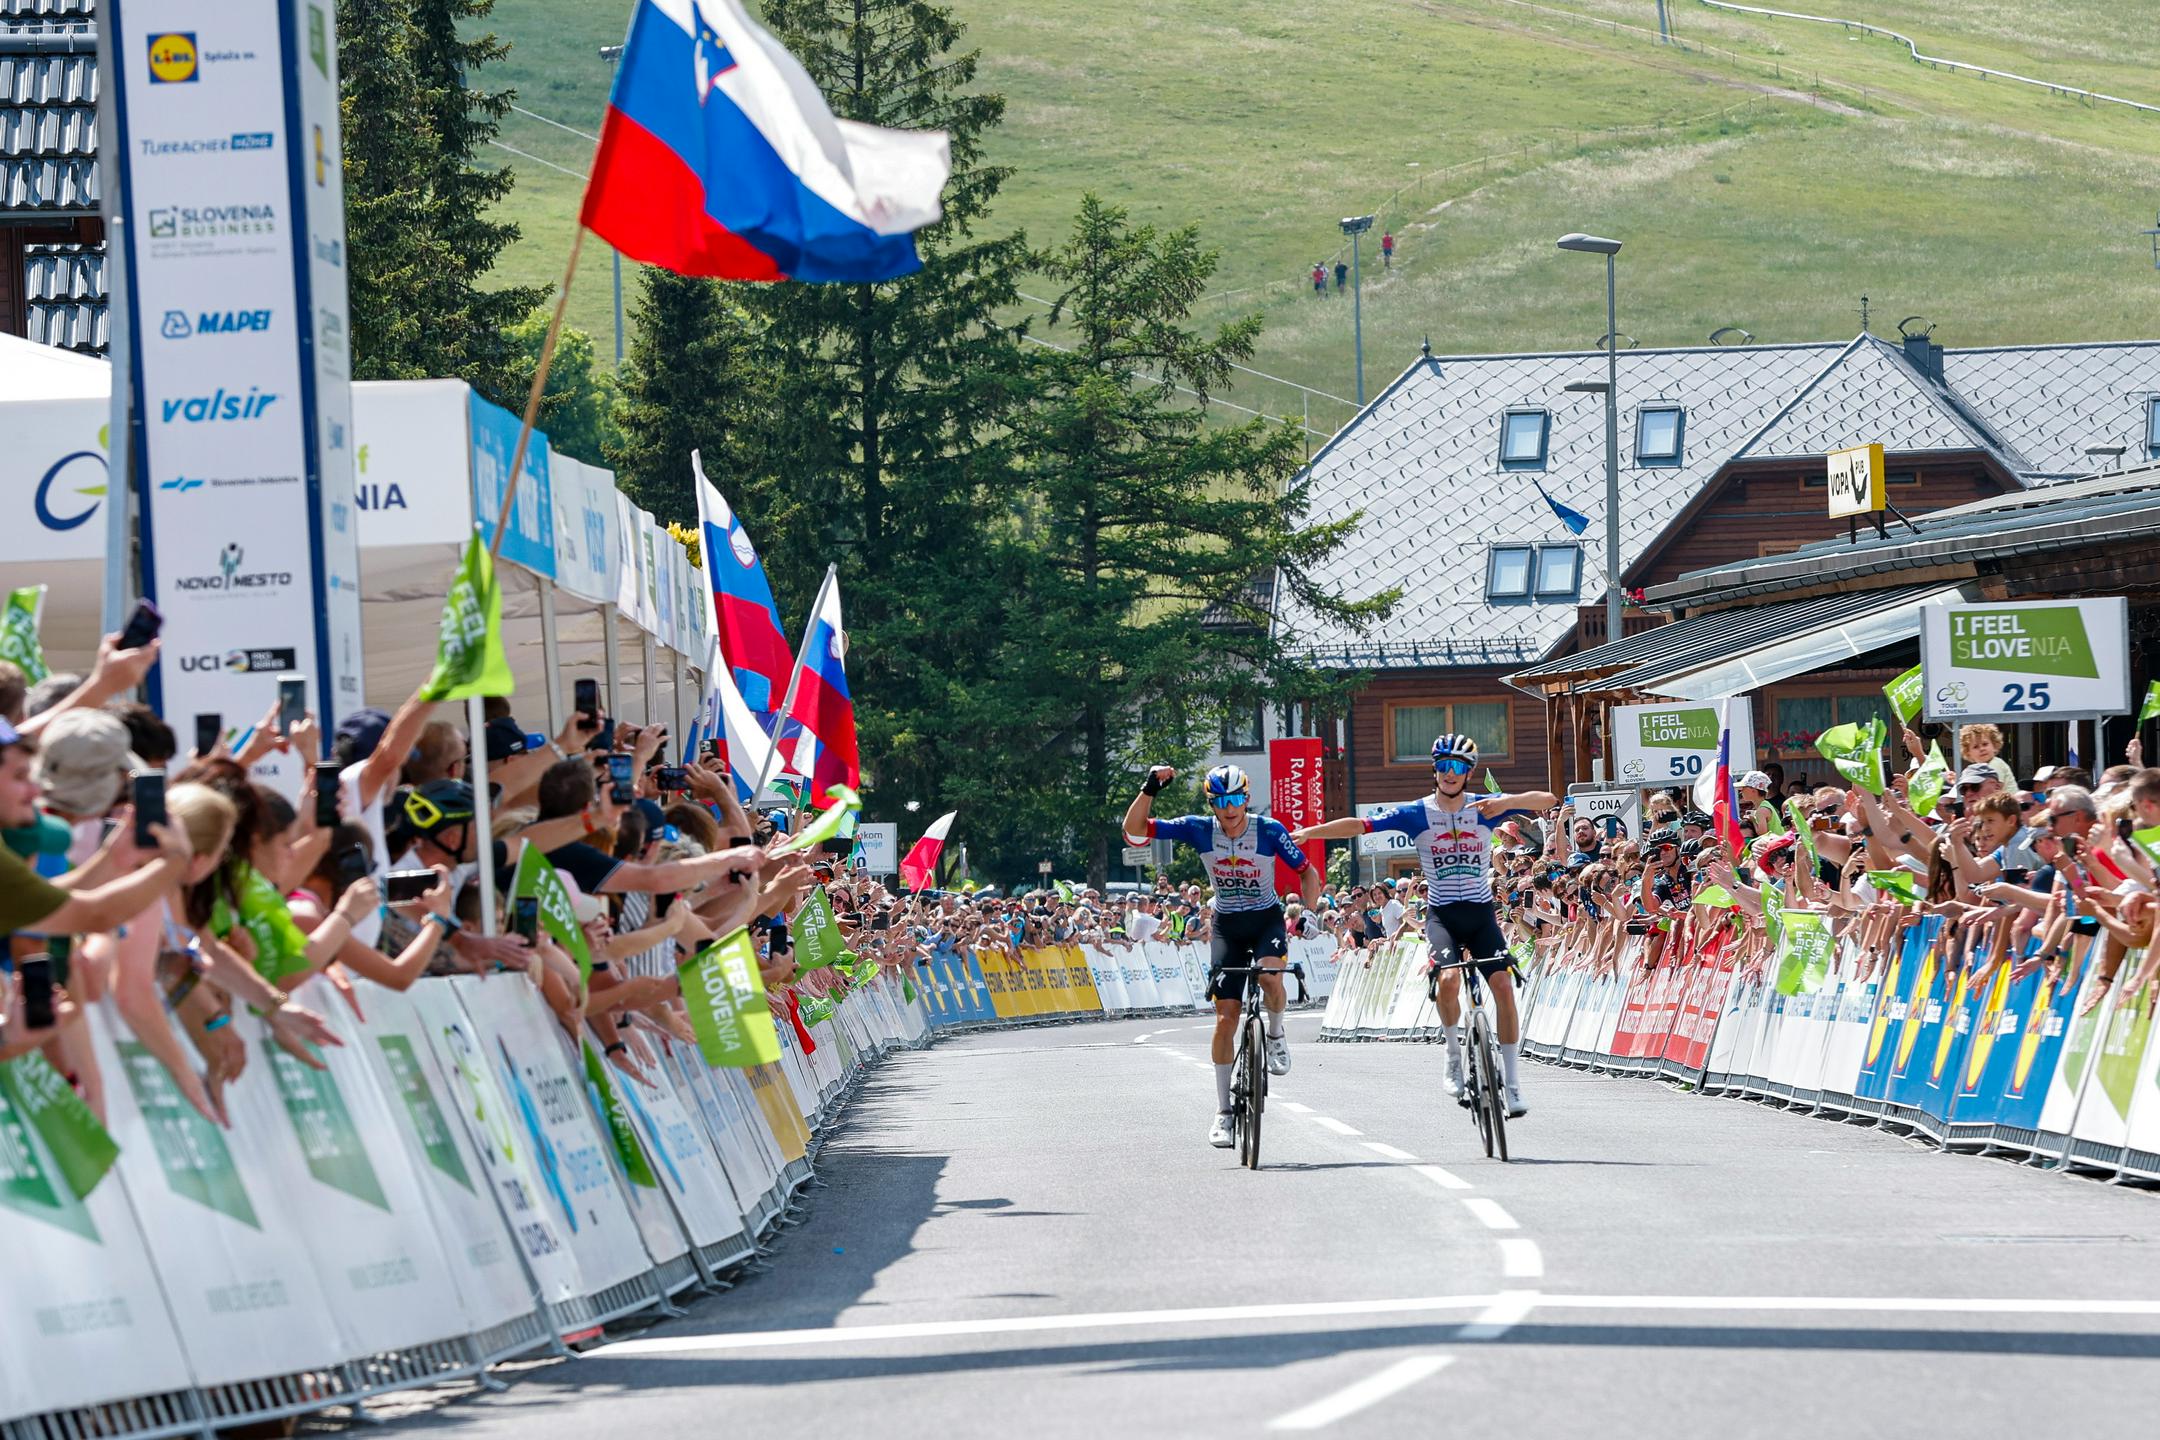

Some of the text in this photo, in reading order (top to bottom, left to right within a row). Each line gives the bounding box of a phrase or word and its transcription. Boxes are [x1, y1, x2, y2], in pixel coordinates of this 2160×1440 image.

[181, 205, 275, 222] SLOVENIA
[181, 222, 275, 237] BUSINESS
[197, 308, 272, 335] MAPEI
[161, 386, 277, 424] valsir
[1854, 460, 1865, 475] PUB
[1830, 471, 1850, 497] VOPA
[175, 571, 293, 591] NOVO MESTO
[1954, 614, 2027, 637] I FEEL
[1956, 635, 2073, 660] SLOVENIA
[180, 654, 221, 673] UCI
[2001, 682, 2051, 712] 25
[1641, 713, 1684, 729] I FEEL
[1642, 725, 1712, 743] SLOVENIA
[1669, 754, 1703, 777] 50
[1290, 757, 1304, 834] RAMADA
[1314, 757, 1323, 826] RAMAD
[1589, 799, 1621, 811] CONA
[1280, 833, 1300, 859] BOSS
[1430, 842, 1483, 856] Red Bull
[1433, 854, 1481, 869] BORA
[1212, 866, 1260, 878] Red Bull
[1437, 867, 1480, 878] hansgrohe
[1216, 877, 1260, 888] BORA
[724, 957, 753, 1011] FEEL
[698, 952, 742, 1053] SLOVENIA
